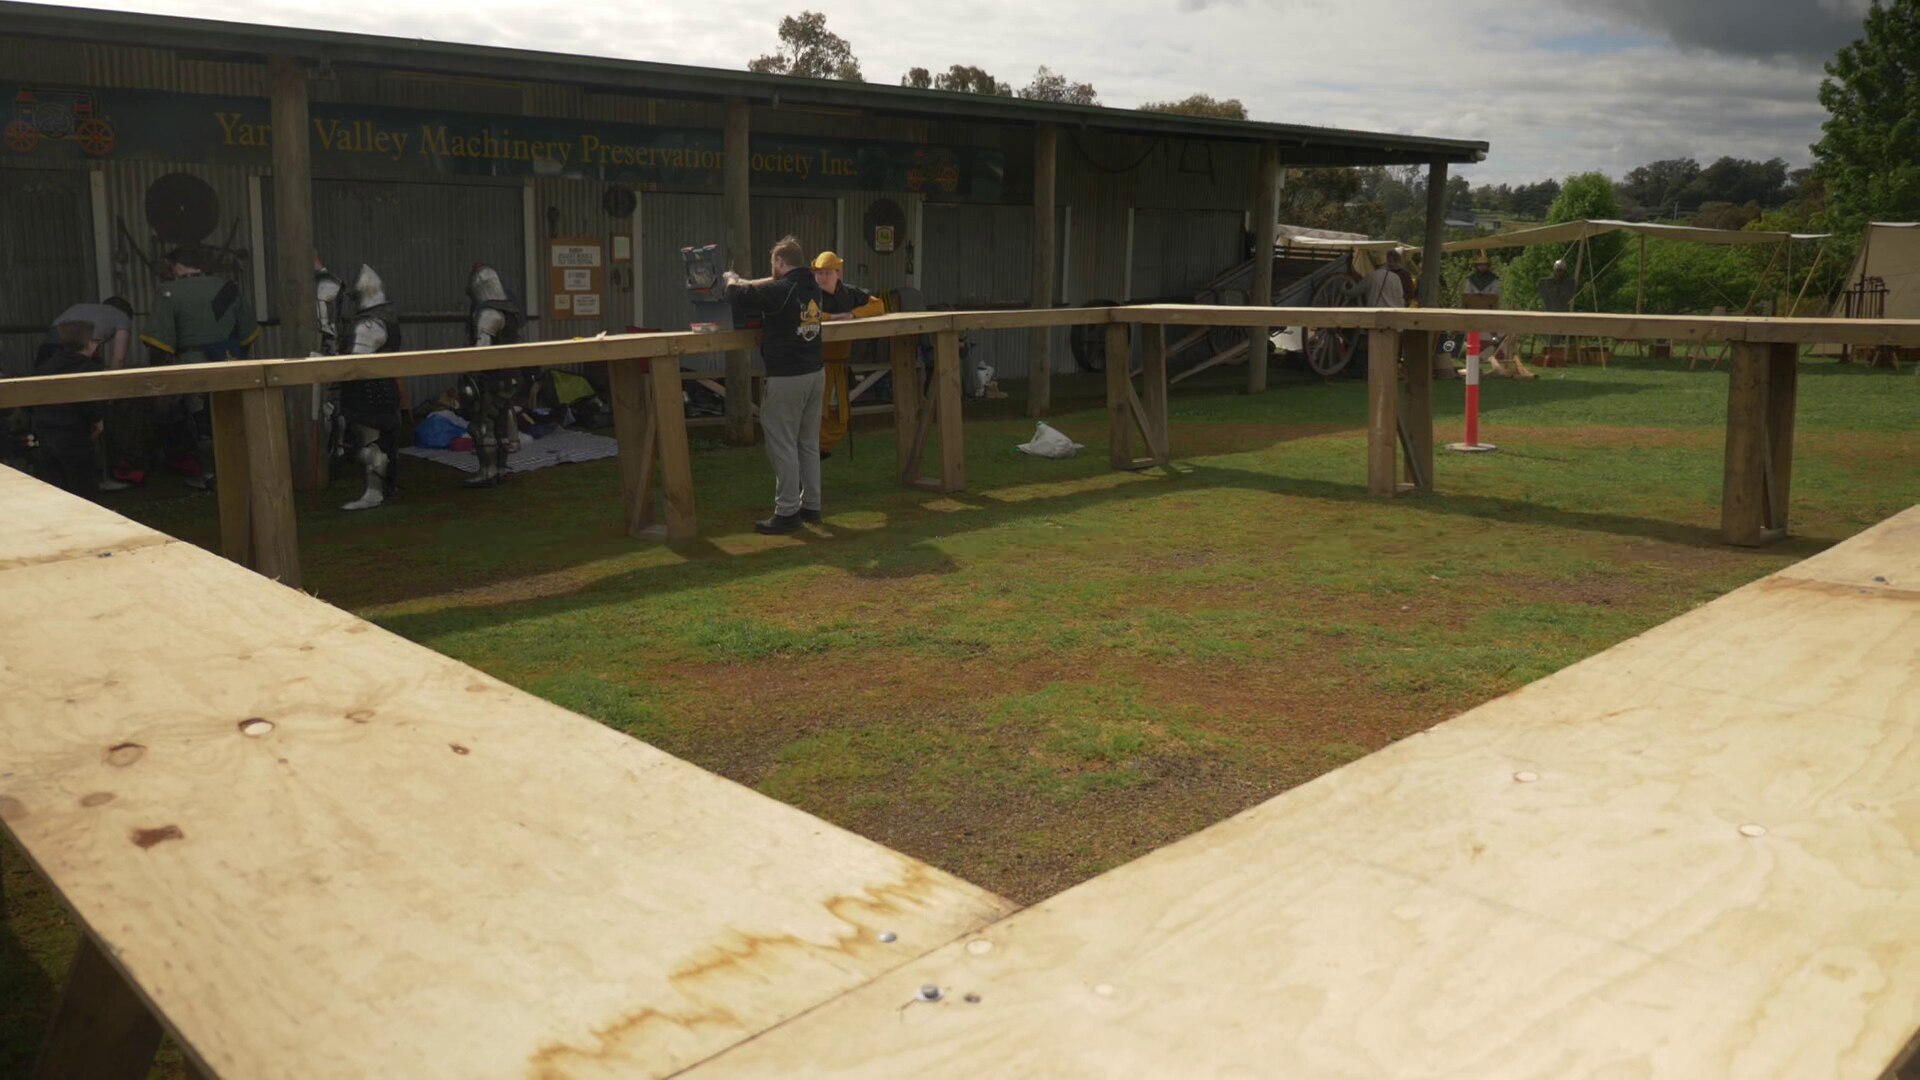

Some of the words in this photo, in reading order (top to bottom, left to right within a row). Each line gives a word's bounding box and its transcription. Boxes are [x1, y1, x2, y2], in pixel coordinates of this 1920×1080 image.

[213, 111, 272, 146] Yar
[312, 116, 409, 161] Valley
[418, 124, 572, 169] Machinery
[750, 142, 814, 181] ociety
[819, 148, 859, 176] Inc.
